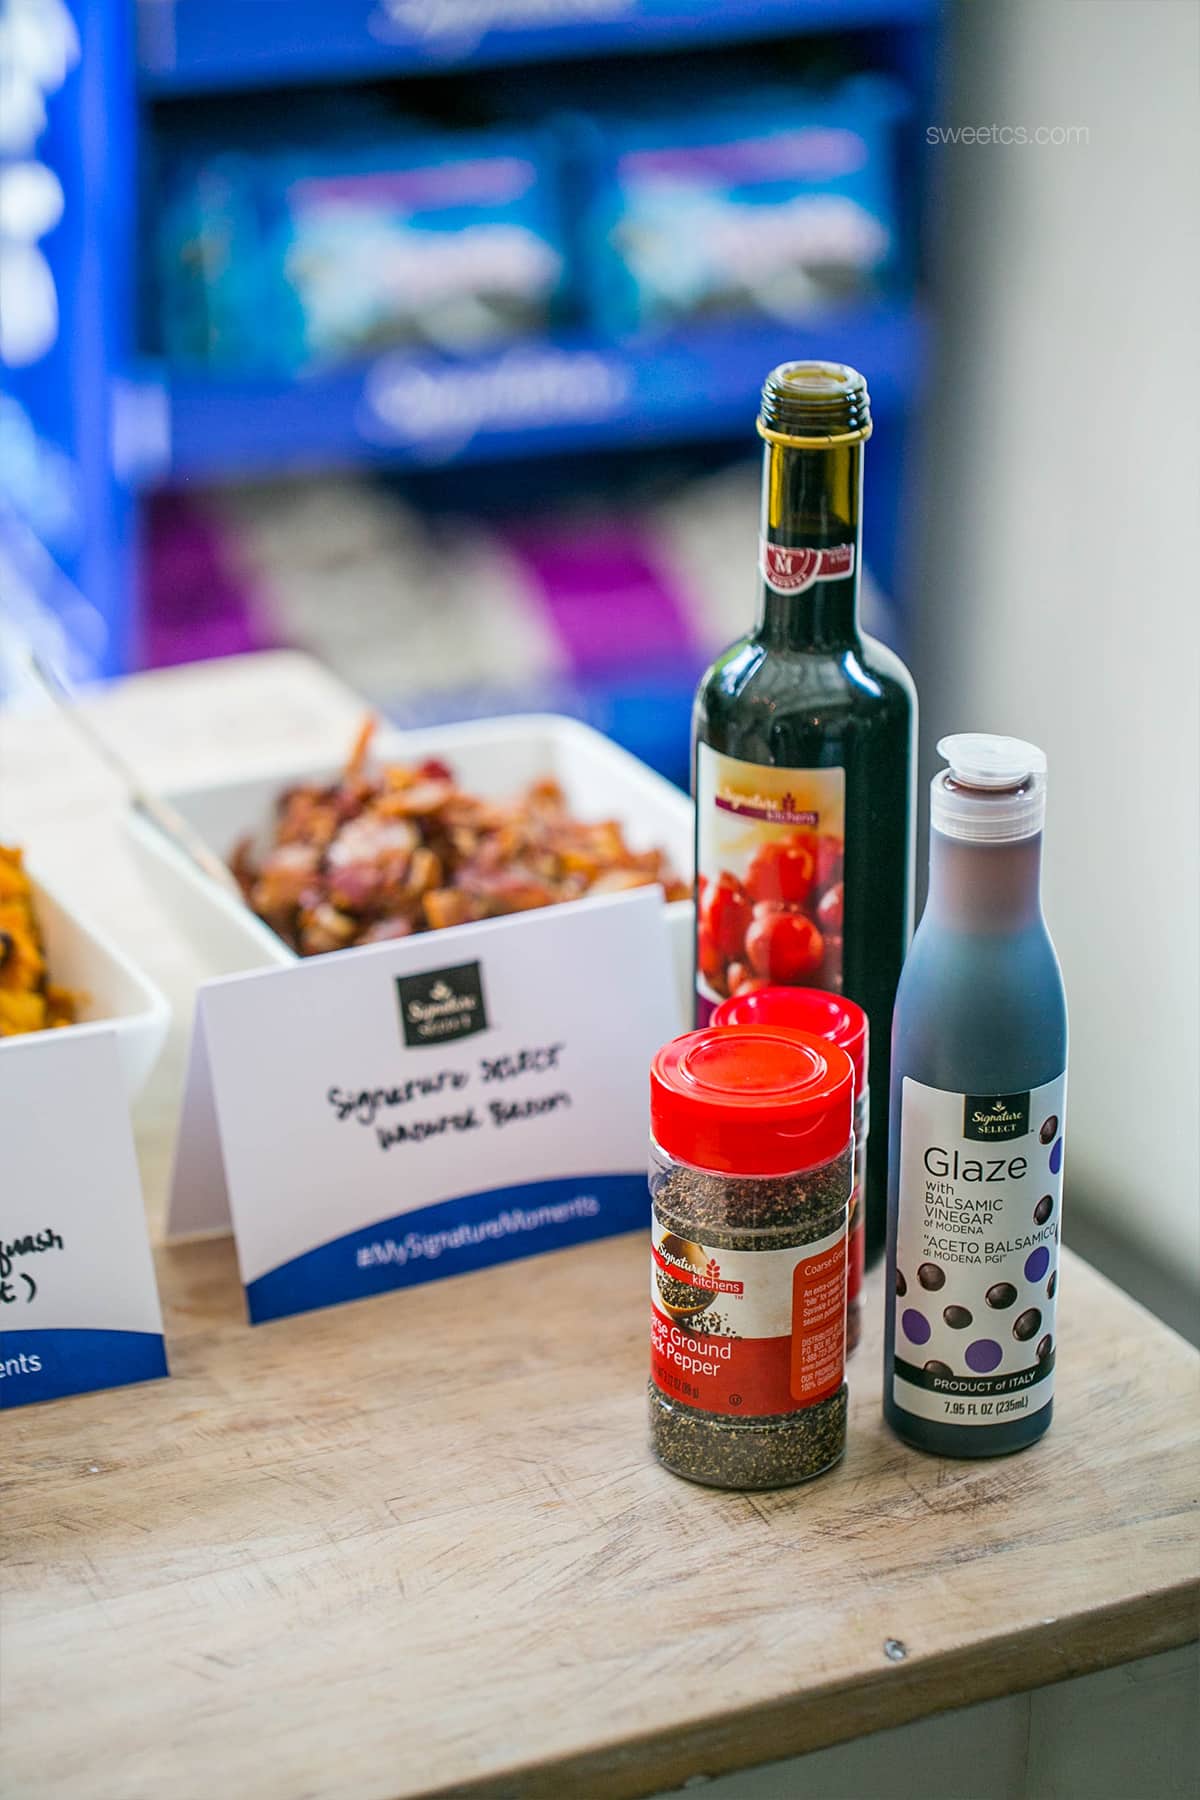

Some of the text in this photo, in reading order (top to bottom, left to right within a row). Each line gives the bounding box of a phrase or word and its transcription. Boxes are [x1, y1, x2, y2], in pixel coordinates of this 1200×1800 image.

[971, 1110, 1023, 1126] Signature
[977, 1123, 1017, 1134] SELECT
[923, 1146, 1028, 1183] Glaze
[925, 1180, 955, 1196] with
[925, 1191, 1004, 1212] BALSAMIC
[924, 1204, 993, 1225] VINEGAR
[355, 1196, 600, 1268] #MySignatureMoments
[923, 1218, 984, 1236] of MODENA
[657, 1241, 704, 1275] Signature
[804, 1258, 832, 1276] Coarse
[922, 1248, 932, 1257] di
[934, 1252, 982, 1265] MODENA
[692, 1273, 740, 1294] kitchens
[670, 1326, 732, 1361] Ground
[666, 1341, 721, 1377] Pepper
[933, 1370, 1036, 1393] PRODUCT of ITALY
[944, 1395, 1029, 1416] 7.95 FL OZ (235mL)
